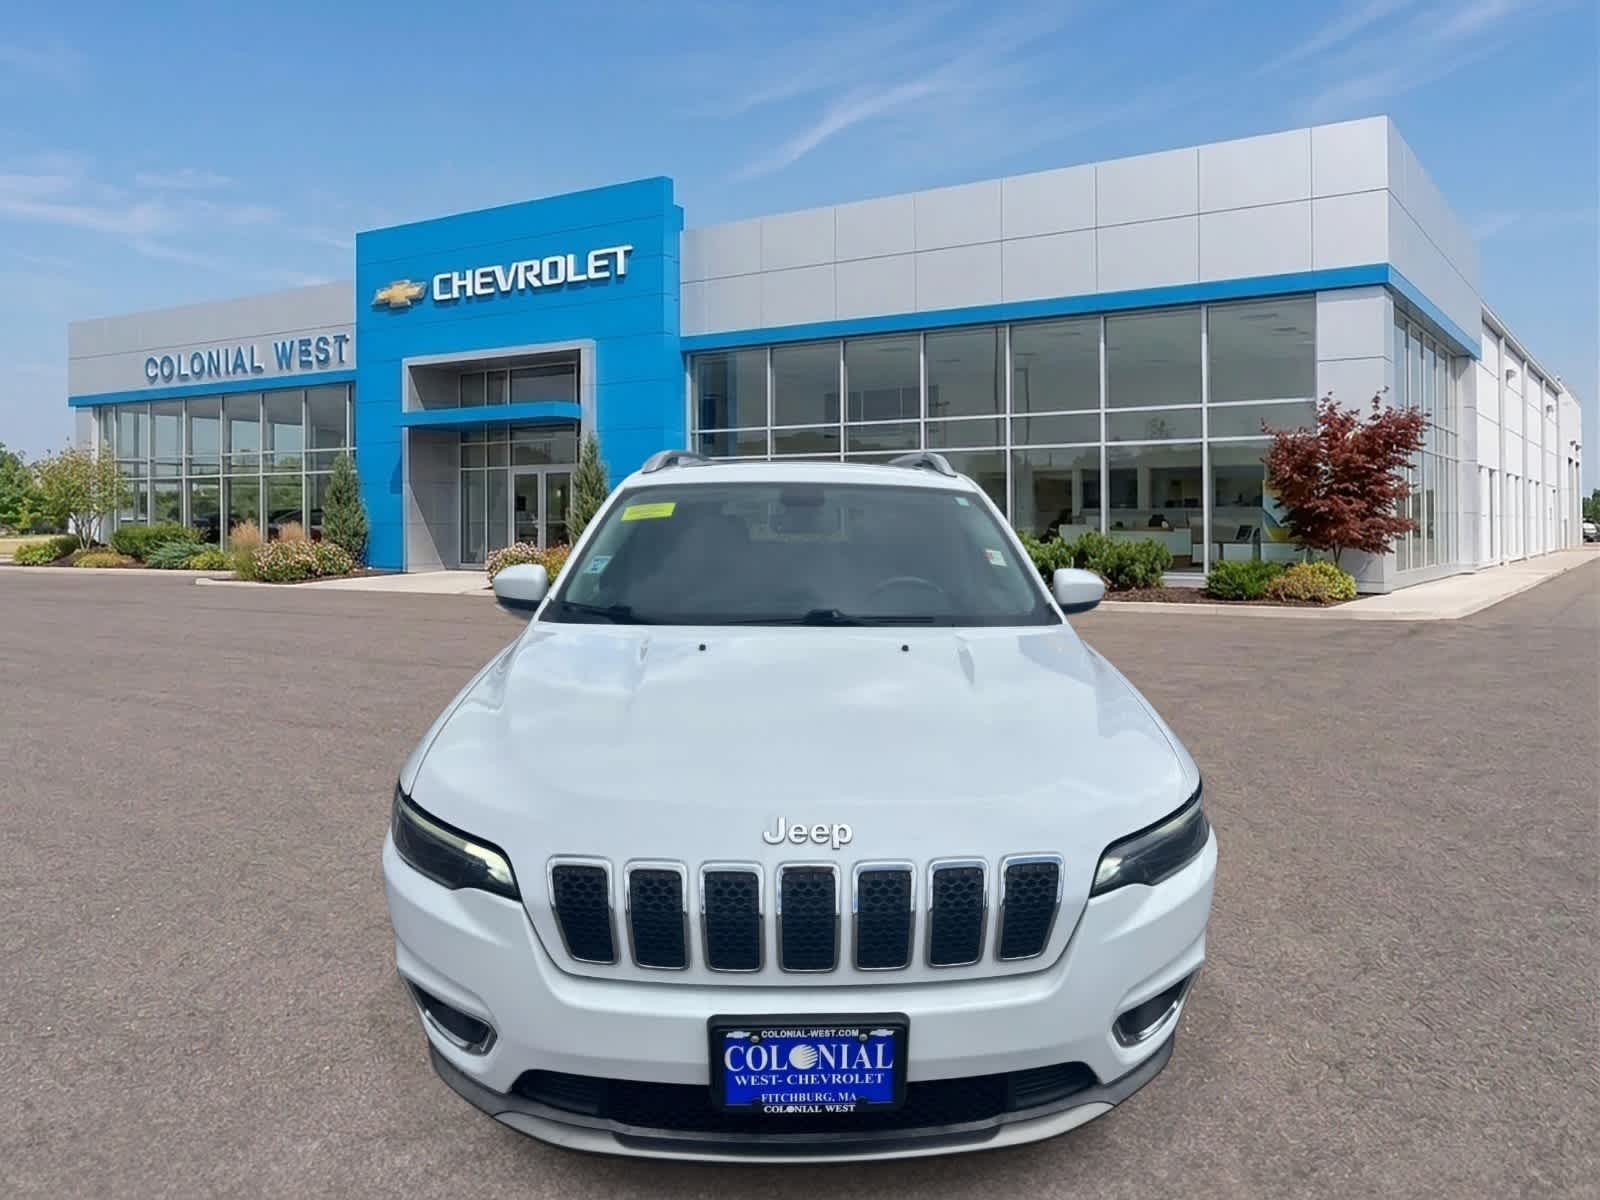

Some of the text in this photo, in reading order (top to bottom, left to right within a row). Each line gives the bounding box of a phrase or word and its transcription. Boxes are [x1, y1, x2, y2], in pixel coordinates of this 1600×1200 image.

[432, 245, 633, 303] CHEVROLET
[145, 334, 350, 384] COLONIAL WEST
[763, 816, 853, 850] Jeep
[761, 1029, 859, 1039] COLONIAL-WEST.COM
[724, 1044, 893, 1072] COLONIAL
[786, 1073, 885, 1085] CHEVROLET
[838, 1092, 857, 1102] MA
[763, 1104, 856, 1114] COLONIAL WEST
